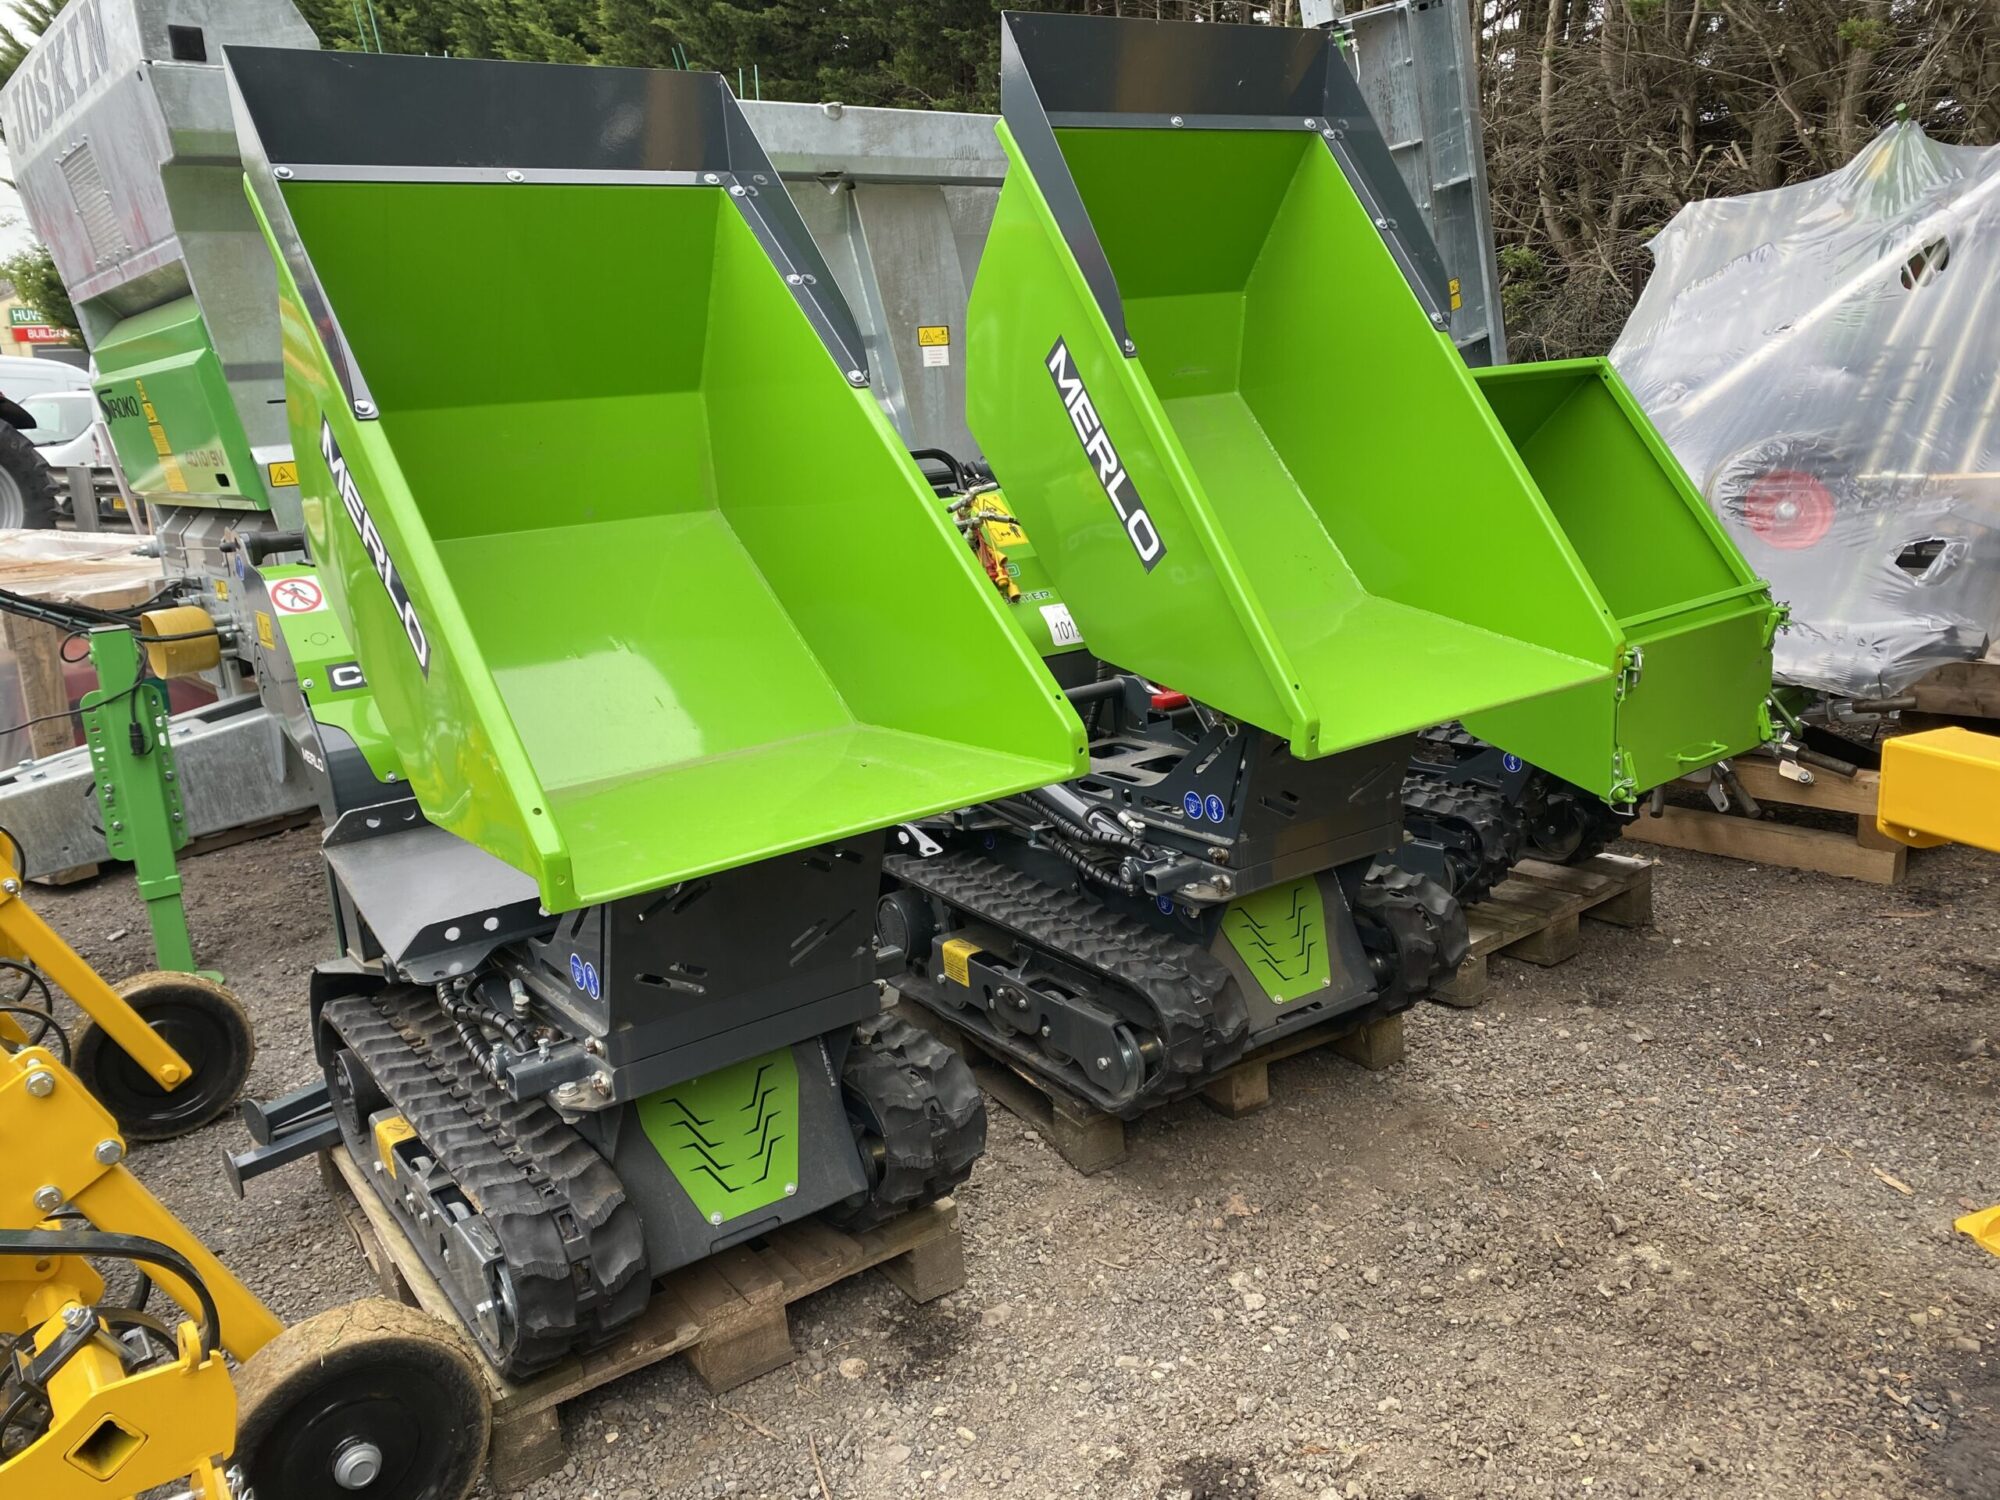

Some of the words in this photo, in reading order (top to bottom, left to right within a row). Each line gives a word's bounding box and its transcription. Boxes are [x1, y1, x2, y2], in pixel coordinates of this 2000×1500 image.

[10, 0, 109, 156] JOSKIN
[98, 388, 140, 425] SIROKO
[1049, 343, 1160, 562] MERLO
[322, 420, 427, 667] MERLO
[1055, 621, 1080, 640] 101
